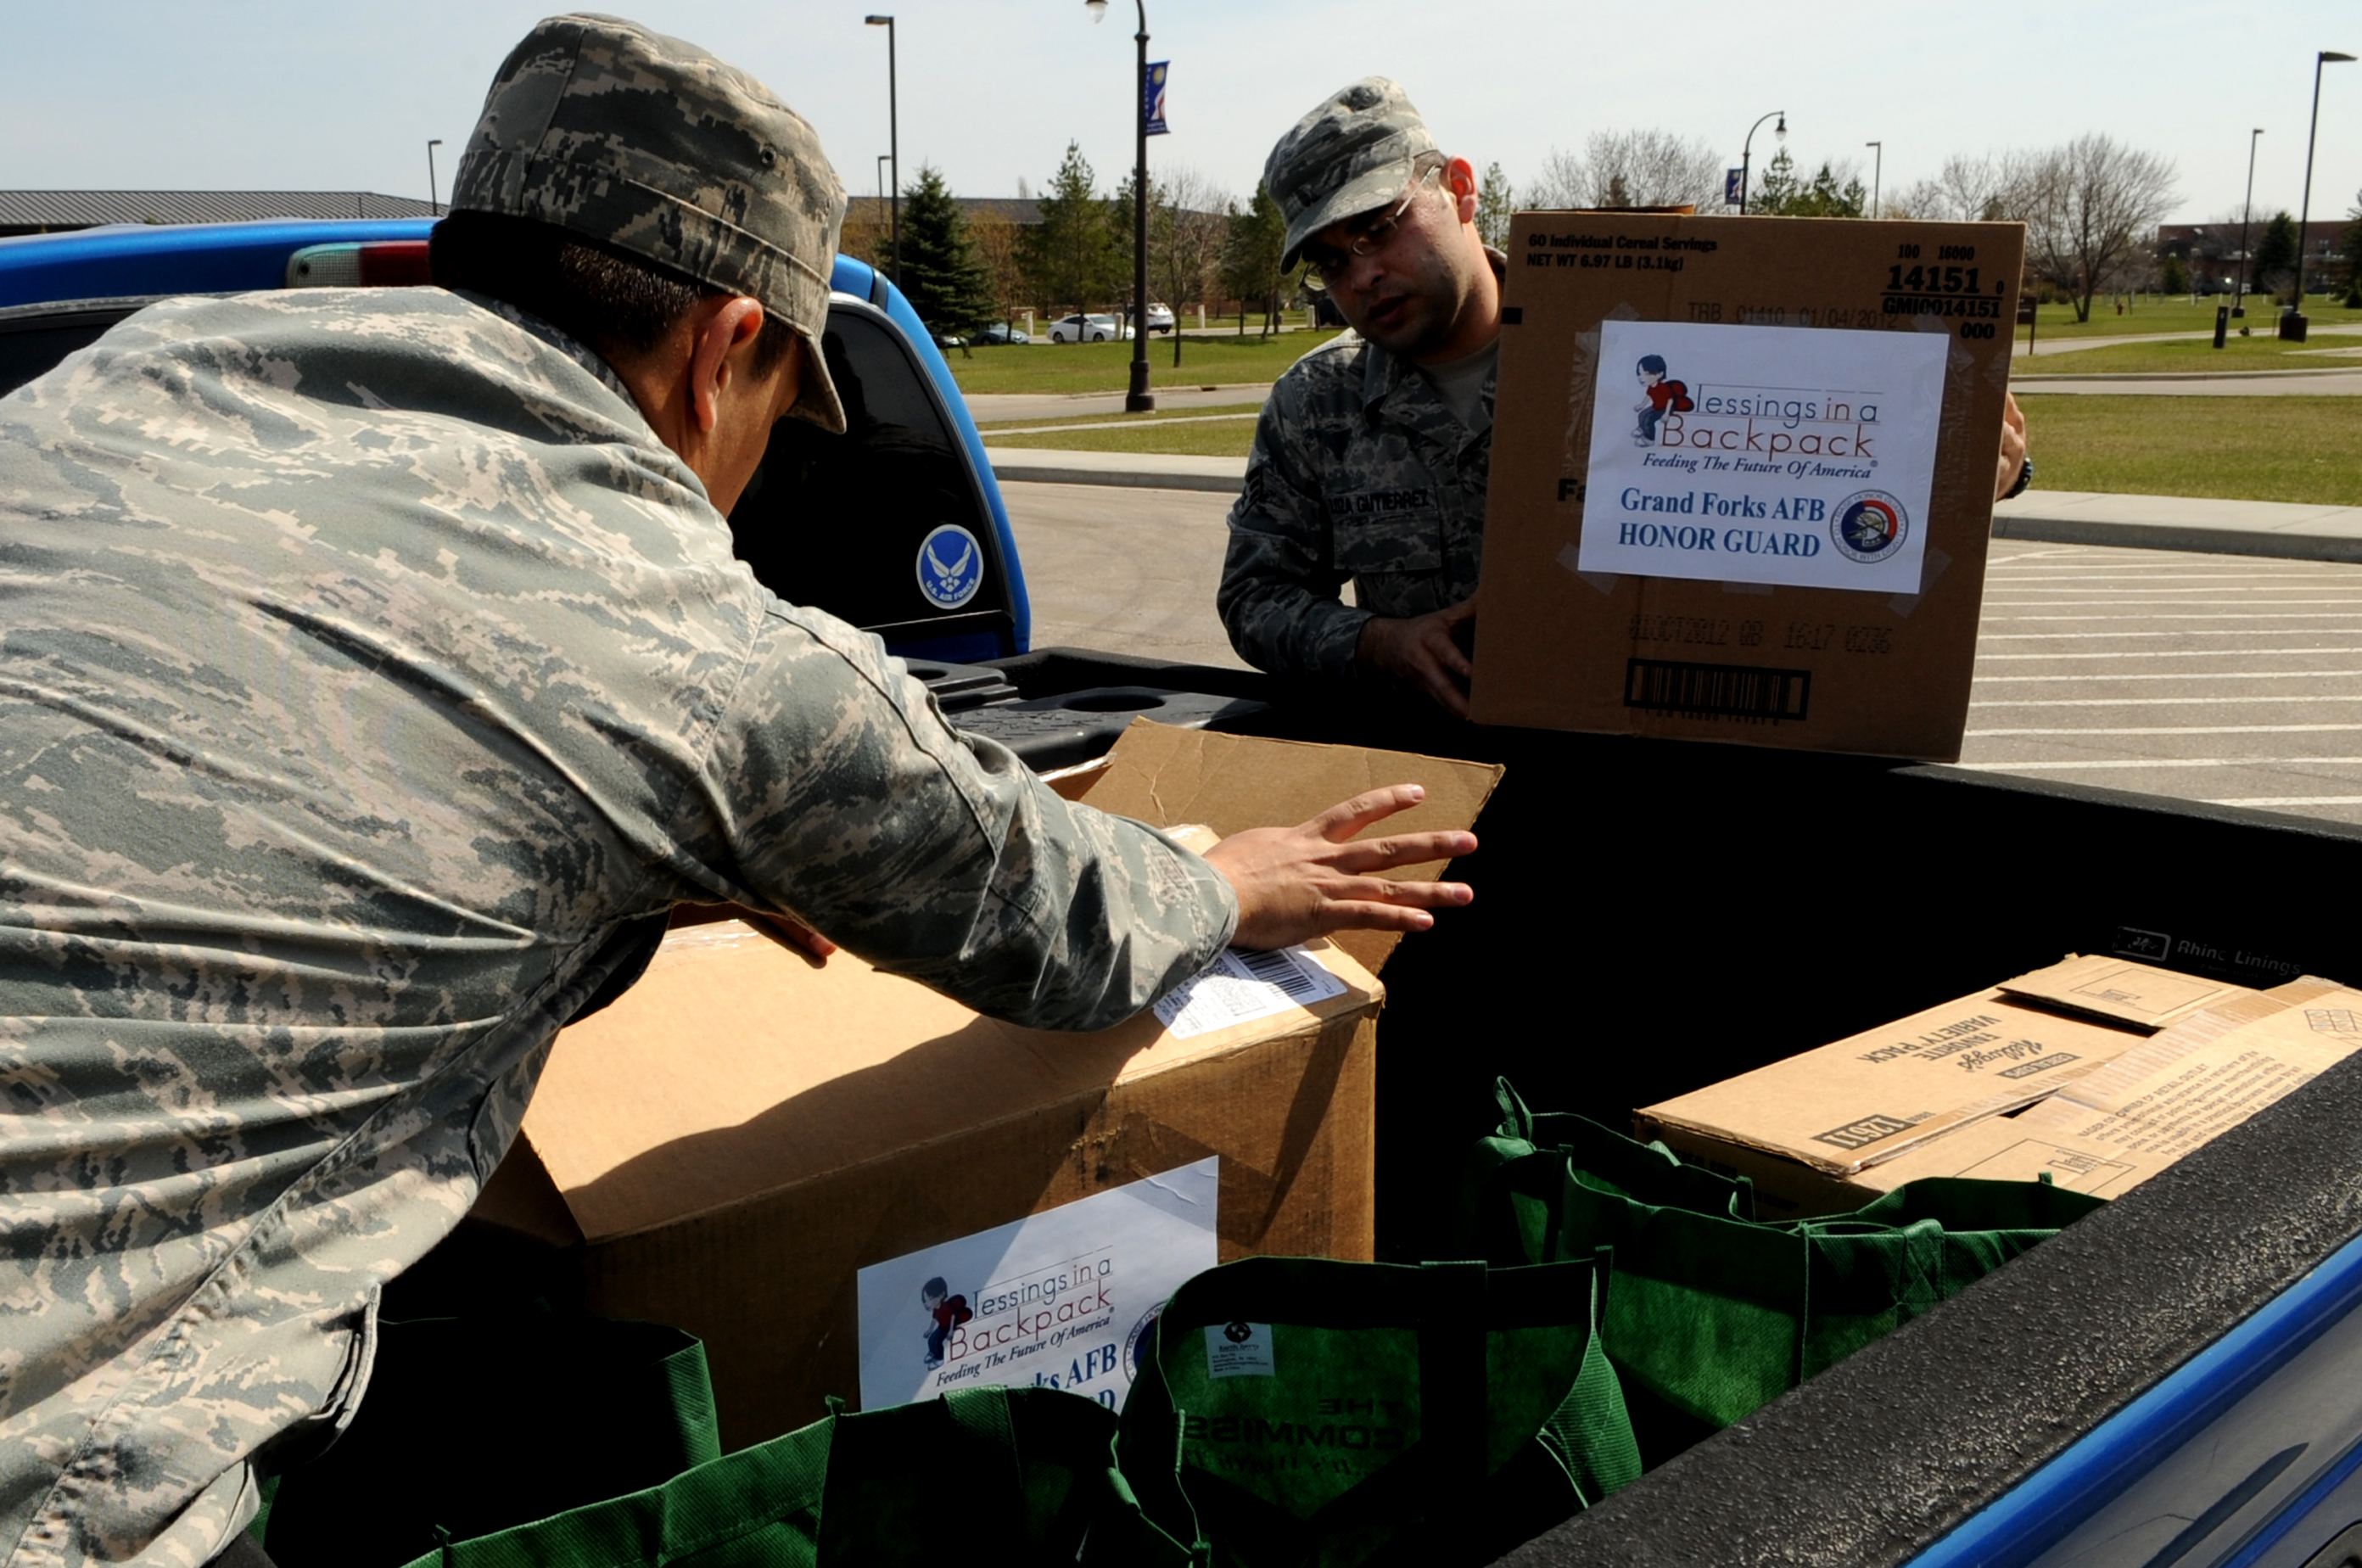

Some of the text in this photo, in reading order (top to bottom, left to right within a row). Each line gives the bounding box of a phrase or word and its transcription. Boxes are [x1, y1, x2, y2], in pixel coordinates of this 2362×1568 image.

[1530, 234, 1717, 253] 60 Individual Cereal Servings
[1898, 244, 1974, 260] 100 16000
[1526, 254, 1684, 272] NET WT 6.97 LB (3.1kg)
[1886, 265, 1980, 294] 14151
[1687, 302, 1721, 322] TRB
[1799, 306, 1900, 329] 01/04/2012
[1882, 296, 2001, 318] GMI0014151
[1960, 322, 1995, 339] 000
[1825, 396, 1850, 422] in
[1859, 404, 1878, 423] a
[1661, 412, 1873, 462] Backpack
[1643, 452, 1872, 479] Feeding The Future Of America
[1357, 490, 1430, 512] GUTIERREZ
[1620, 487, 1826, 522] Grand Forks AFB
[1618, 522, 1821, 557] HONOR GUARD
[938, 592, 953, 602] AIR
[954, 577, 977, 601] FORCE
[2234, 949, 2302, 977] Linings
[1855, 1015, 2002, 1065] VARIETY PACK
[1911, 1032, 2001, 1062] FAVORITE
[1956, 1039, 2043, 1072] Kellogg's
[1822, 1117, 1906, 1147] 12611
[1072, 1263, 1092, 1286] in
[1097, 1258, 1111, 1276] a
[949, 1279, 1111, 1362] Backpack
[936, 1362, 982, 1387] Feeding
[985, 1352, 1006, 1370] The
[1009, 1340, 1047, 1361] Future
[1049, 1331, 1066, 1348] Of
[1065, 1316, 1111, 1341] America
[1064, 1343, 1117, 1389] AFB
